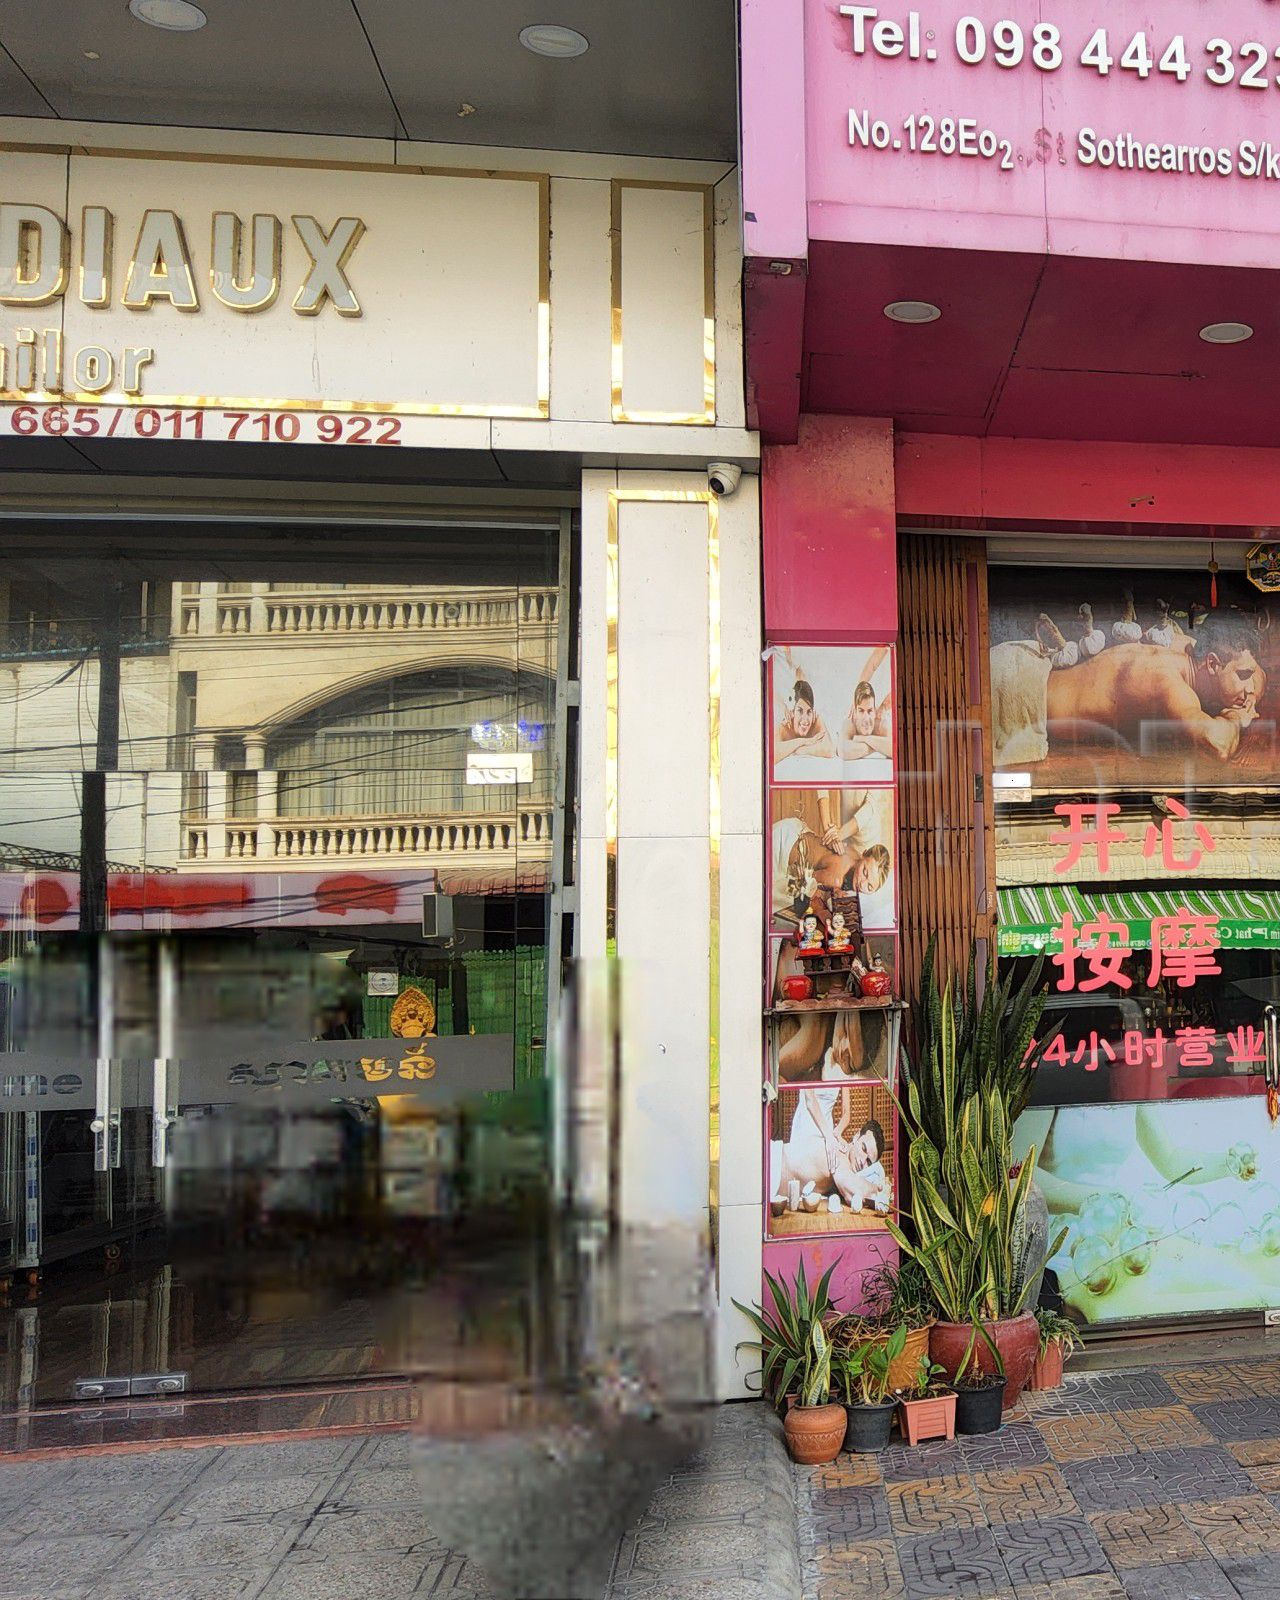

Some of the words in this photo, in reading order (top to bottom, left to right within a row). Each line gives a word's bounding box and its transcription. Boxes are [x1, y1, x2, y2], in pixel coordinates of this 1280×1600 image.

[955, 16, 1063, 71] 098
[1080, 28, 1192, 81] 444
[1077, 127, 1233, 177] Sothearros
[0, 326, 154, 396] ilor
[223, 411, 301, 443] 710
[316, 414, 402, 446] 922
[1049, 797, 1217, 874] 开心
[1051, 907, 1223, 993] 按摩
